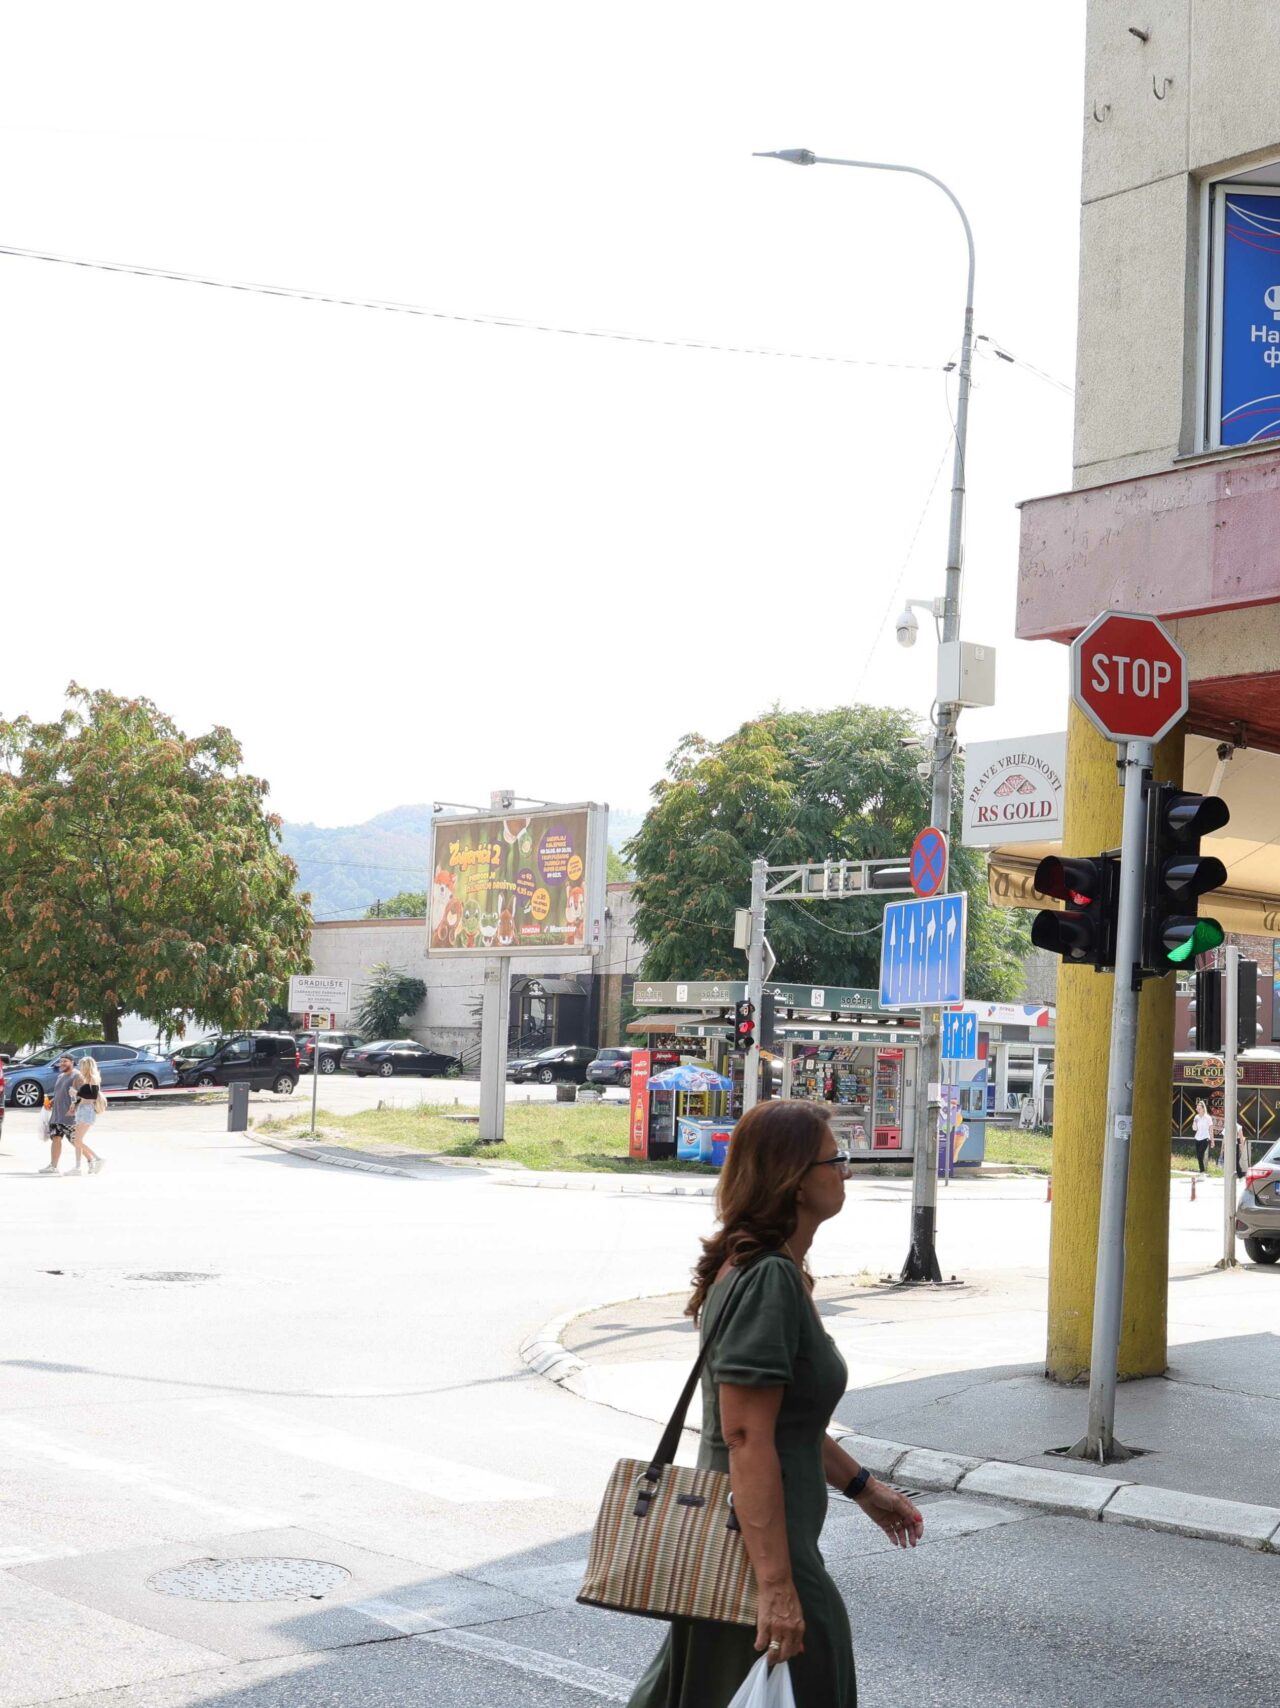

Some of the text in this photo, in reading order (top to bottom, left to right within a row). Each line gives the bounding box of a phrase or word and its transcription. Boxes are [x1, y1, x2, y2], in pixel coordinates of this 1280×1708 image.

[1091, 653, 1172, 699] STOP
[969, 751, 1063, 804] PRAVE VRIJEDNOSTI
[977, 800, 1052, 823] RS GOLD
[493, 844, 501, 865] 2
[298, 979, 343, 987] GRADILIŠTE
[1185, 1066, 1241, 1077] BET GOLN
